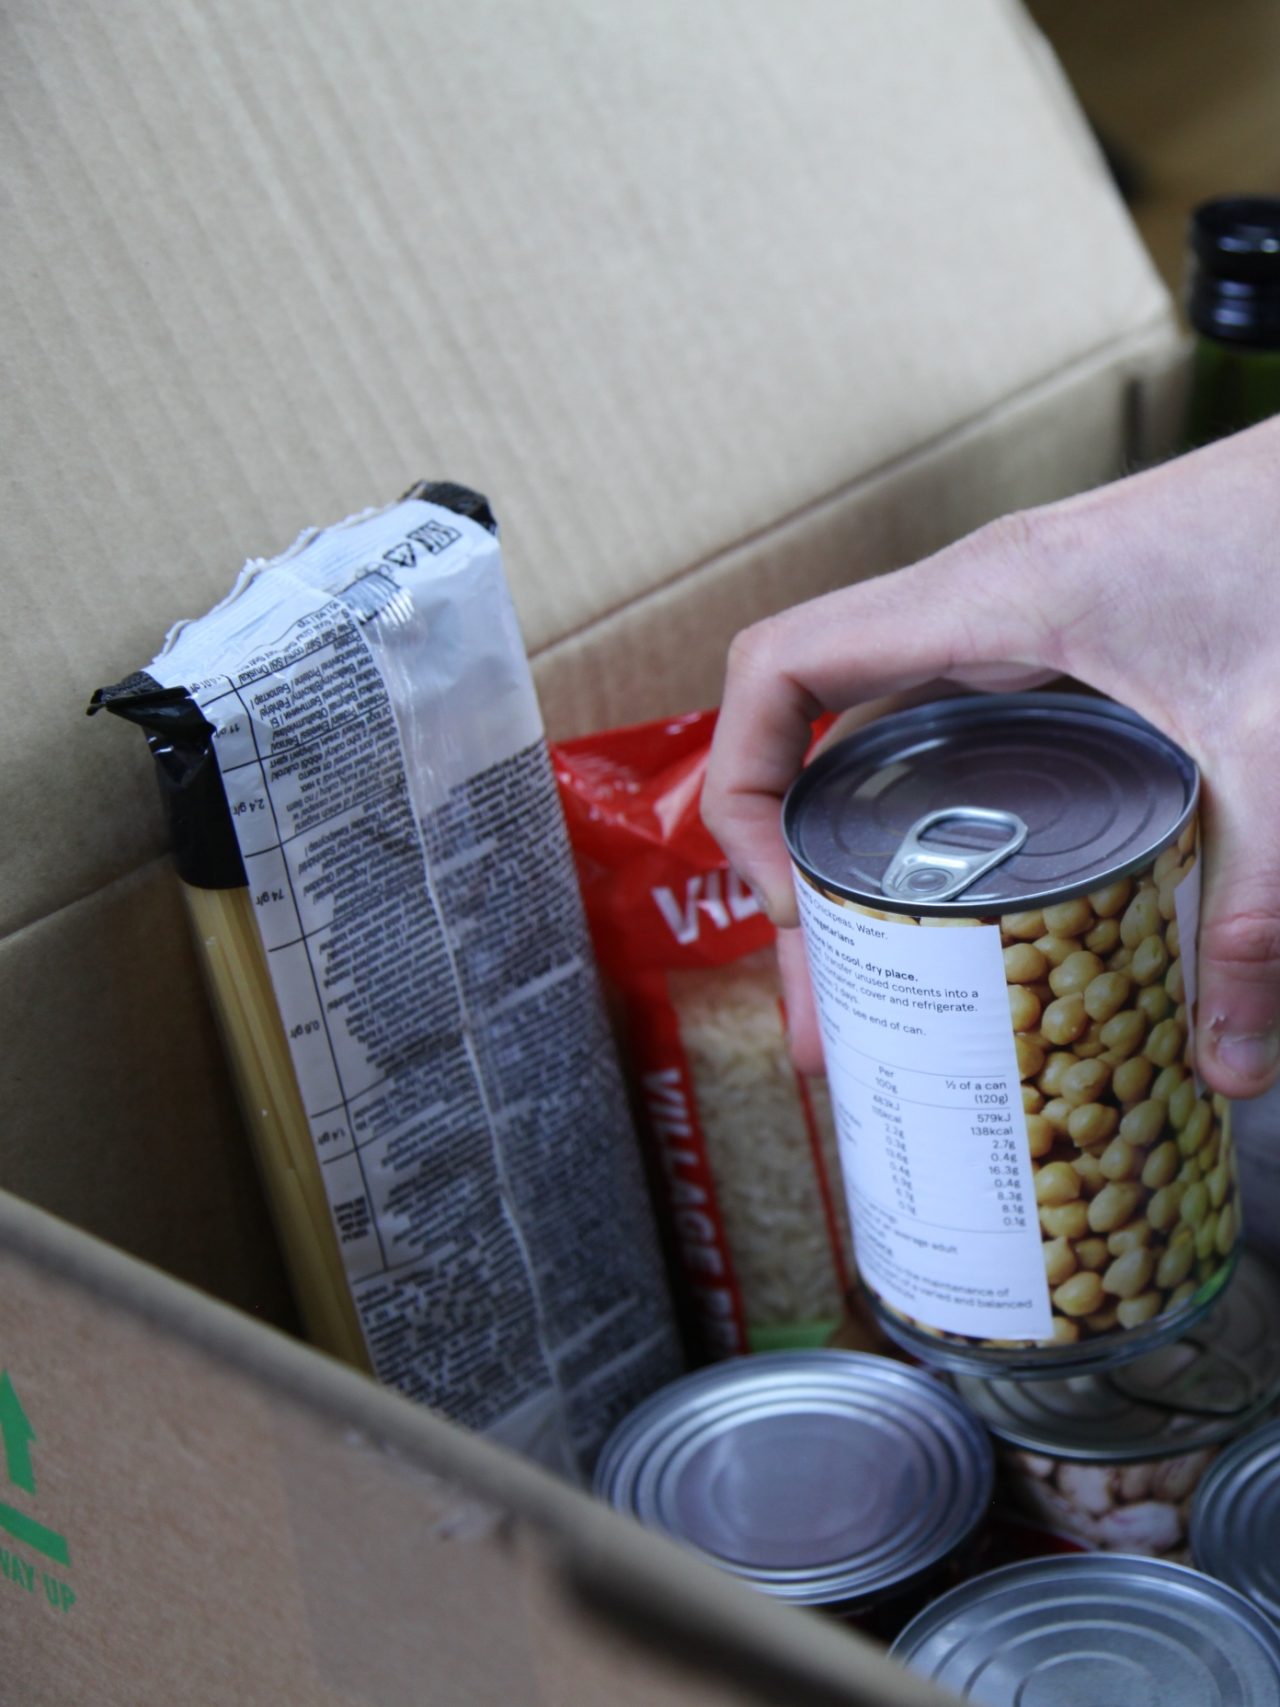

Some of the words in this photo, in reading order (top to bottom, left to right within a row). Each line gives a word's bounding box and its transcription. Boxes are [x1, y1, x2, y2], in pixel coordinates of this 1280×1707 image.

[865, 960, 883, 977] dry
[884, 966, 919, 984] place.
[854, 972, 889, 991] unused
[891, 982, 942, 999] contents
[944, 988, 969, 999] into
[971, 990, 980, 999] a
[860, 986, 888, 1003] cover
[889, 993, 910, 1008] and
[912, 998, 979, 1014] refrigerate.
[869, 1012, 888, 1028] end
[889, 1018, 900, 1031] of
[902, 1024, 927, 1036] can.
[878, 1064, 895, 1079] Per
[958, 1079, 972, 1091] of
[974, 1081, 983, 1091] a
[984, 1080, 1007, 1091] can
[974, 1093, 1009, 1106] (120g)
[977, 1112, 1012, 1124] 579kJ
[970, 1125, 1014, 1137] 138kcal
[992, 1139, 1016, 1151] 2.7g
[990, 1152, 1018, 1164] 0.4g
[643, 1068, 725, 1278] VILLAGE
[988, 1165, 1020, 1177] 16.3g
[993, 1178, 1021, 1190] 0.4g
[1003, 1216, 1027, 1228] 0.1g
[976, 1297, 1033, 1310] balanced
[42, 1571, 78, 1615] UP
